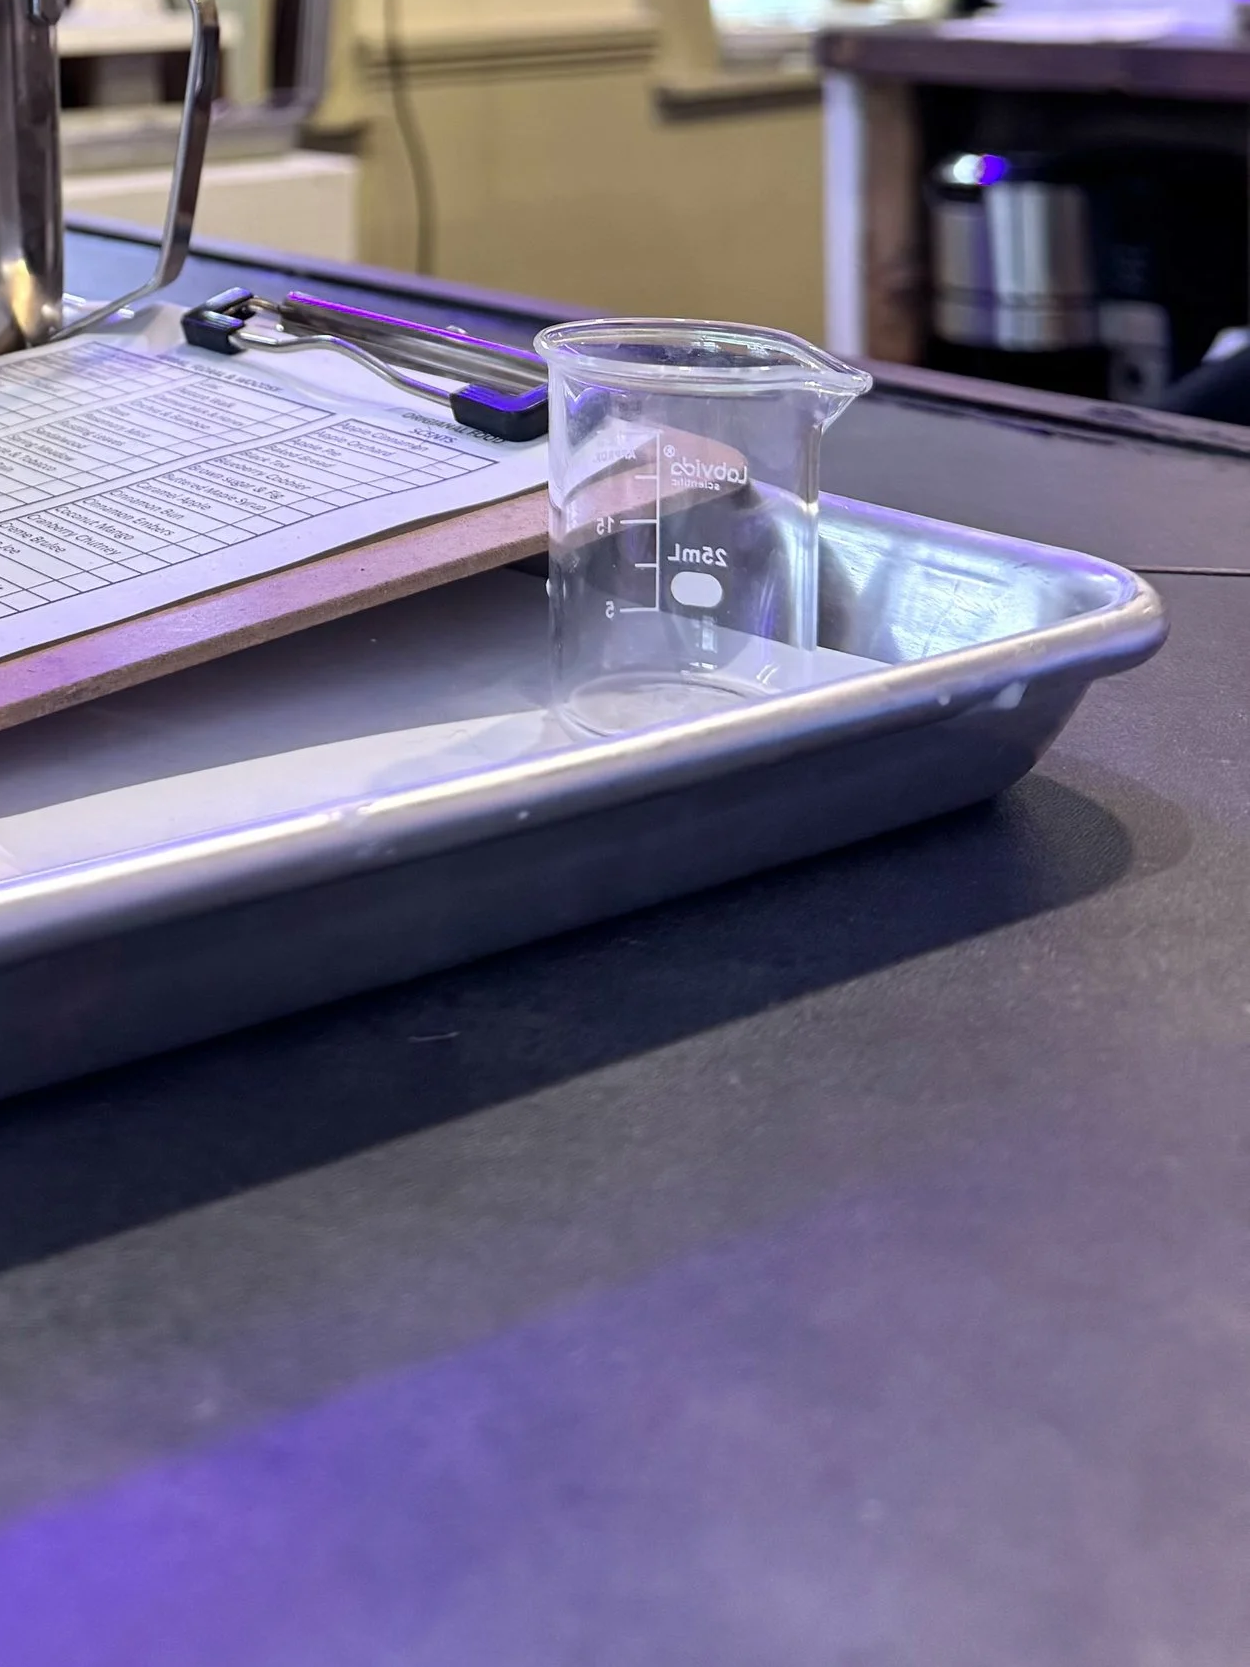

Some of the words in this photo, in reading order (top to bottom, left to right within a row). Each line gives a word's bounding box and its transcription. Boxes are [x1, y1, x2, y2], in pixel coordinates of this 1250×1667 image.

[410, 428, 458, 444] SCENTS
[187, 465, 225, 478] Brown
[262, 490, 284, 499] Fig
[213, 457, 267, 476] Blueberry
[263, 473, 311, 490] Cobbler
[109, 489, 164, 510] Cinnamon
[159, 508, 186, 519] Bun
[135, 481, 185, 499] Caramel
[176, 496, 211, 510] Apple
[161, 473, 210, 490] Buttered
[201, 487, 237, 500] Maple
[232, 497, 267, 512] Syrup
[53, 505, 103, 525] Coconut
[95, 522, 136, 540] Mango
[81, 497, 136, 519] Cinnamon
[131, 517, 176, 535] Embers
[26, 513, 79, 537] Cranberry
[73, 534, 122, 556] Chutney
[29, 535, 68, 552] Brulee
